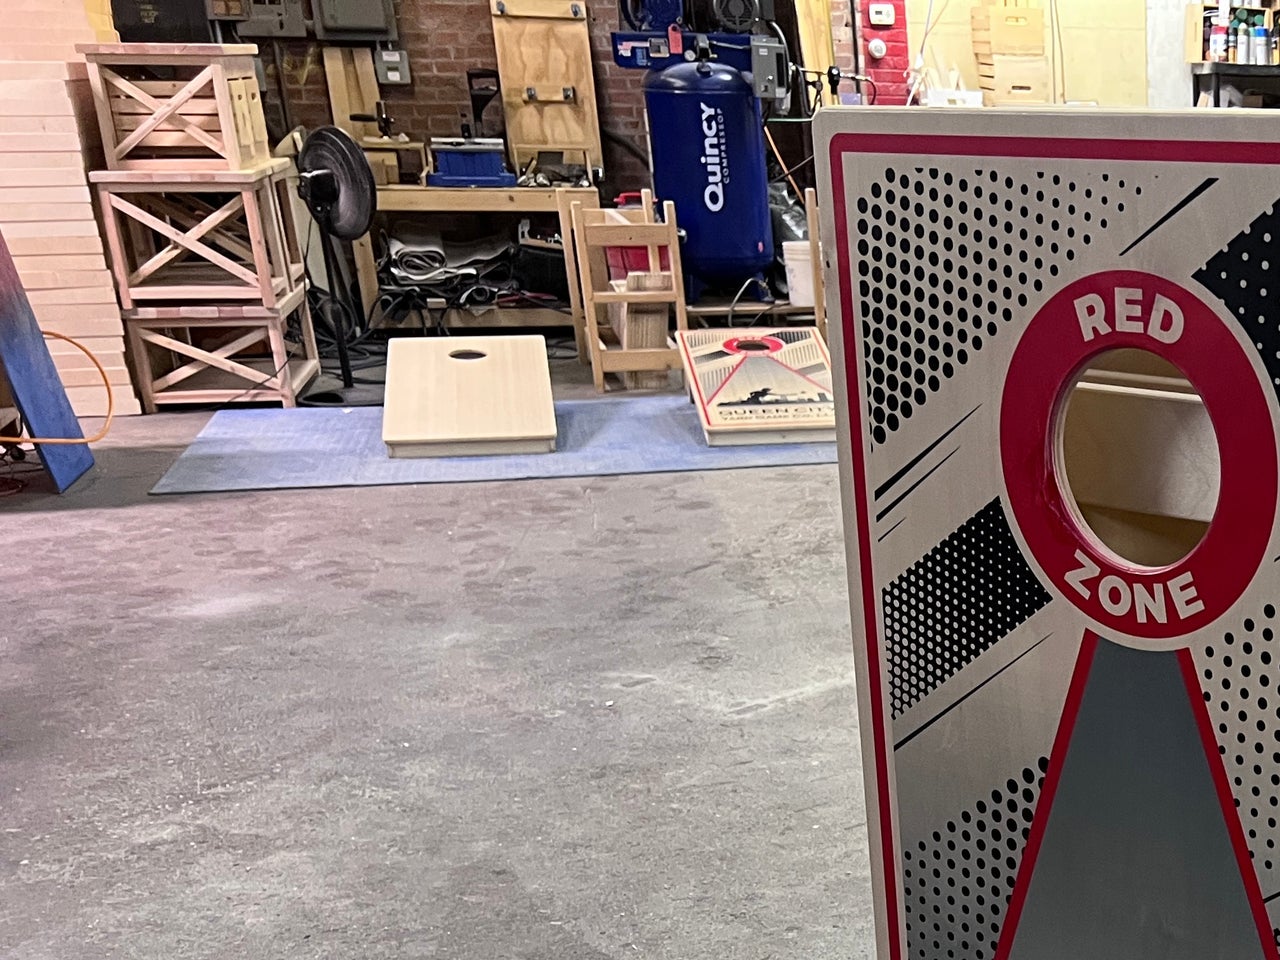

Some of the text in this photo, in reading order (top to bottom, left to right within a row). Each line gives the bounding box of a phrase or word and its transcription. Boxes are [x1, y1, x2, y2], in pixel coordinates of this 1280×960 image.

[700, 102, 724, 212] Quincy
[1073, 286, 1185, 344] RED
[1064, 548, 1205, 623] ZONE
